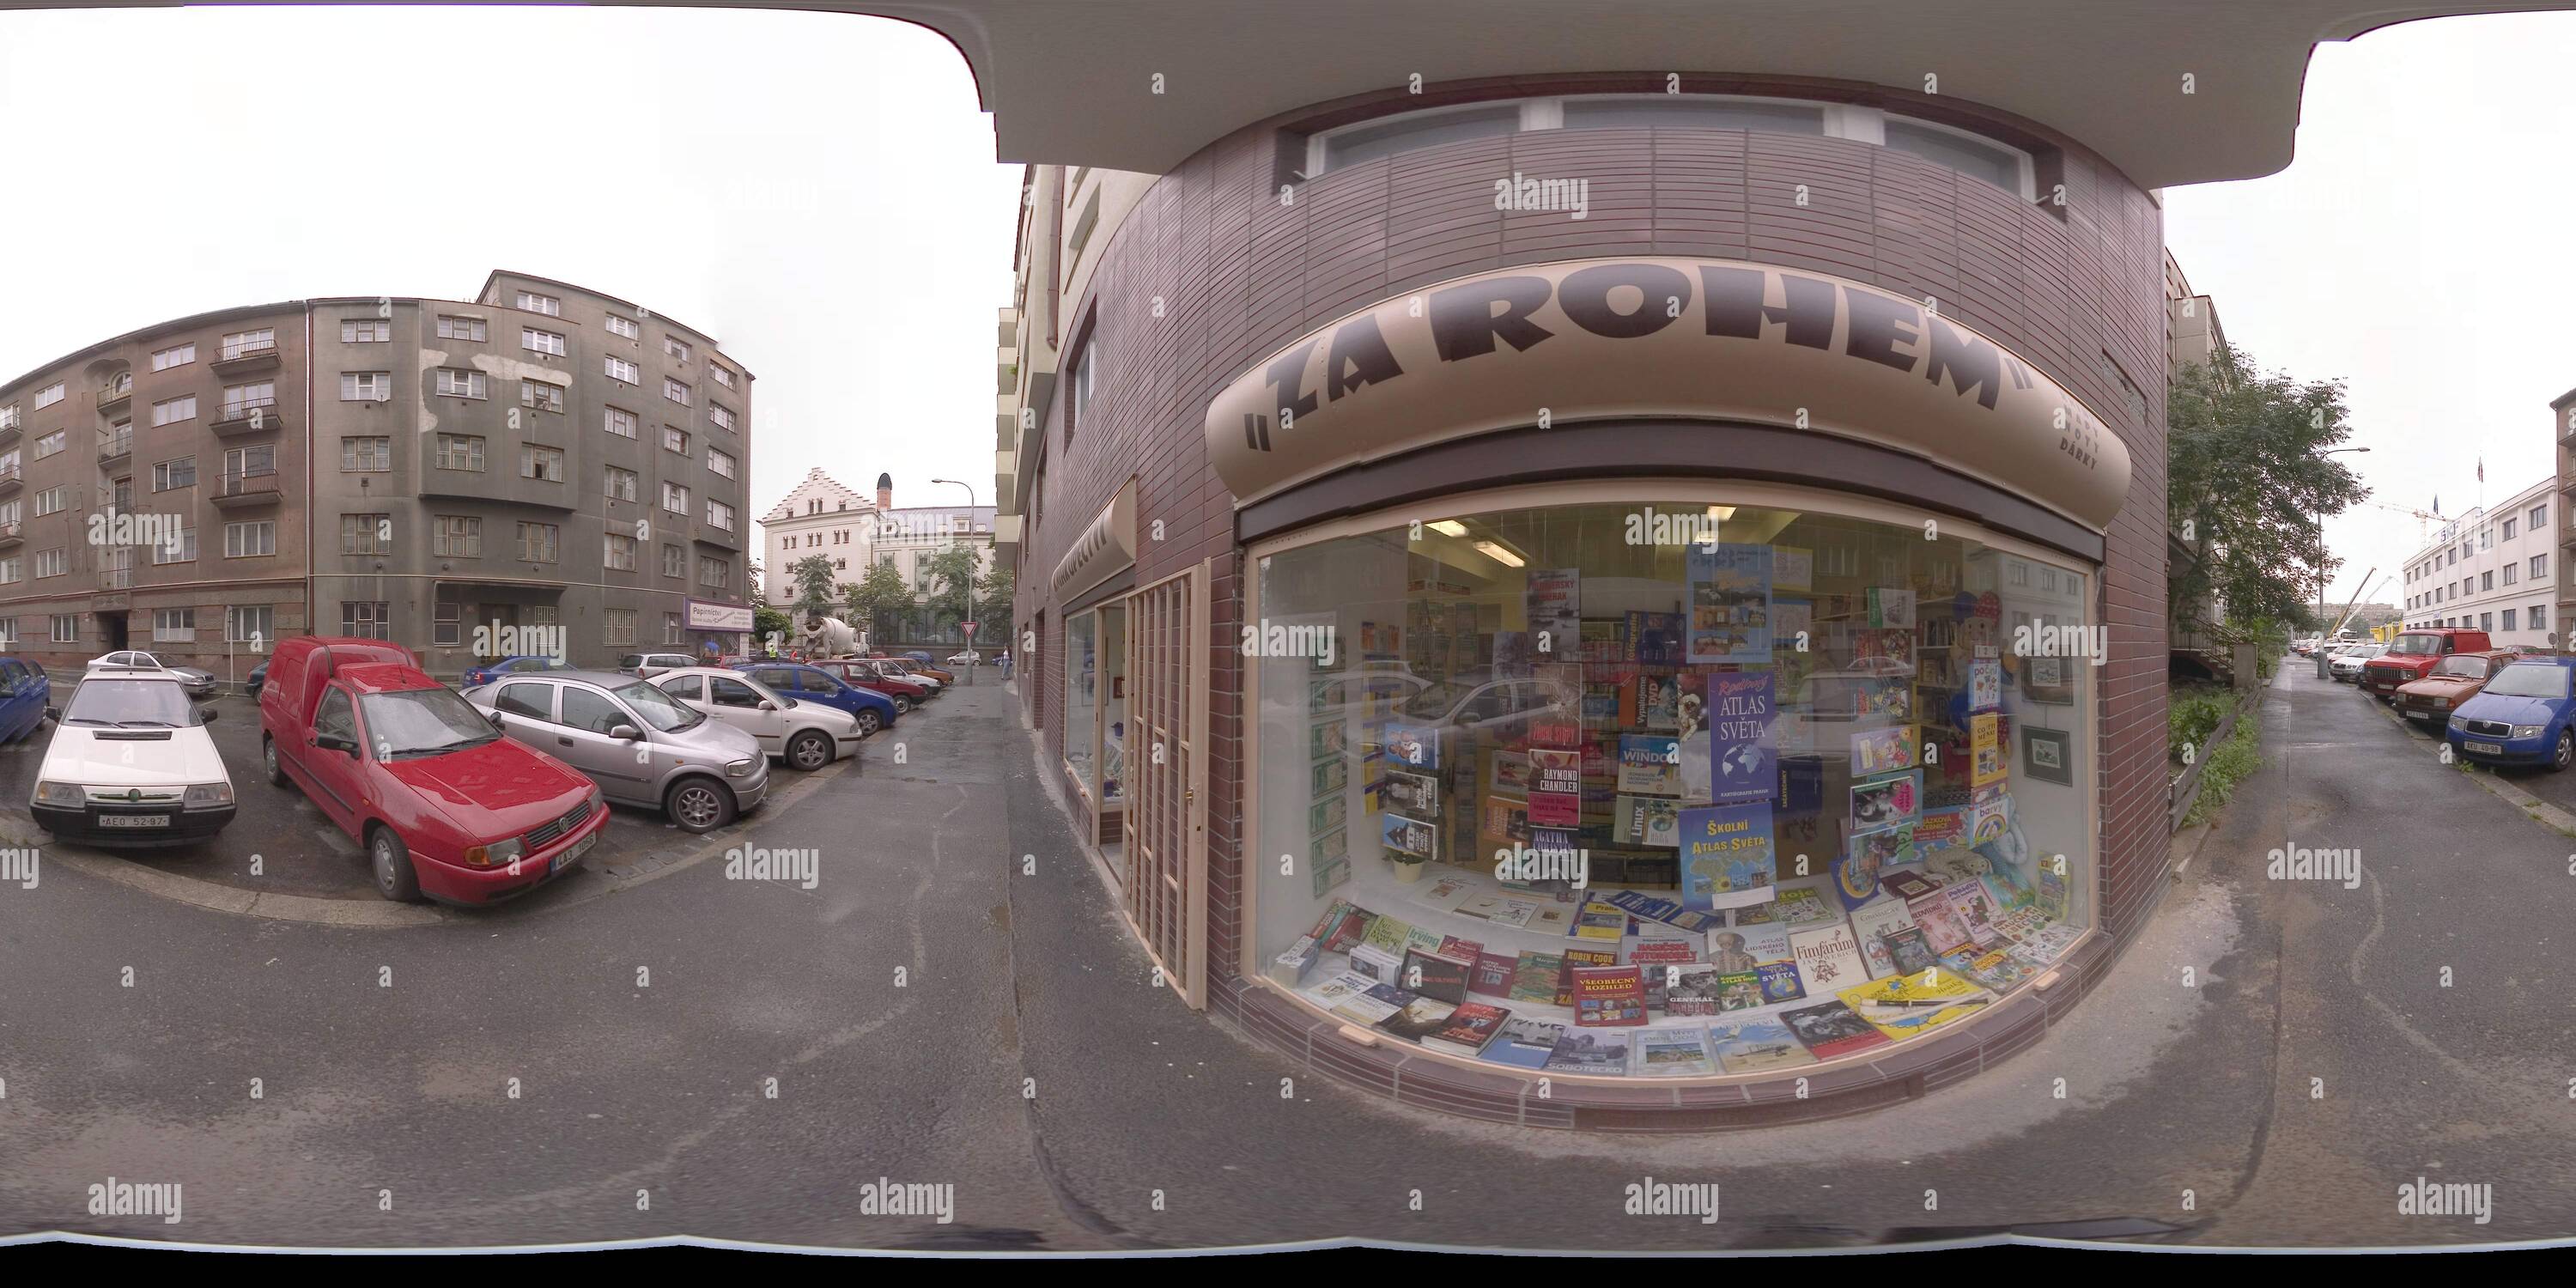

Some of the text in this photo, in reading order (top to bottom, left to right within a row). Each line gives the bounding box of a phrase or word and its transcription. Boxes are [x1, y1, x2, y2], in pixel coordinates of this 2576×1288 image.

[2060, 436, 2098, 471] DÁRKY
[1720, 696, 1765, 716] ATLAS
[1721, 716, 1766, 740] SVĚTA
[1624, 750, 1674, 762] WINDO
[1544, 769, 1577, 781] RAYMOND
[1540, 780, 1577, 793] CHANDLER
[1979, 805, 2002, 817] barvy
[1631, 806, 1645, 837] Linux
[1534, 830, 1569, 843] AGATHA
[1408, 928, 1440, 948] Irving
[1567, 951, 1614, 963] ROBIN COOK
[1579, 976, 1637, 985] VŠEOBECNÝ
[1547, 1062, 1622, 1073] SOBOTECKO
